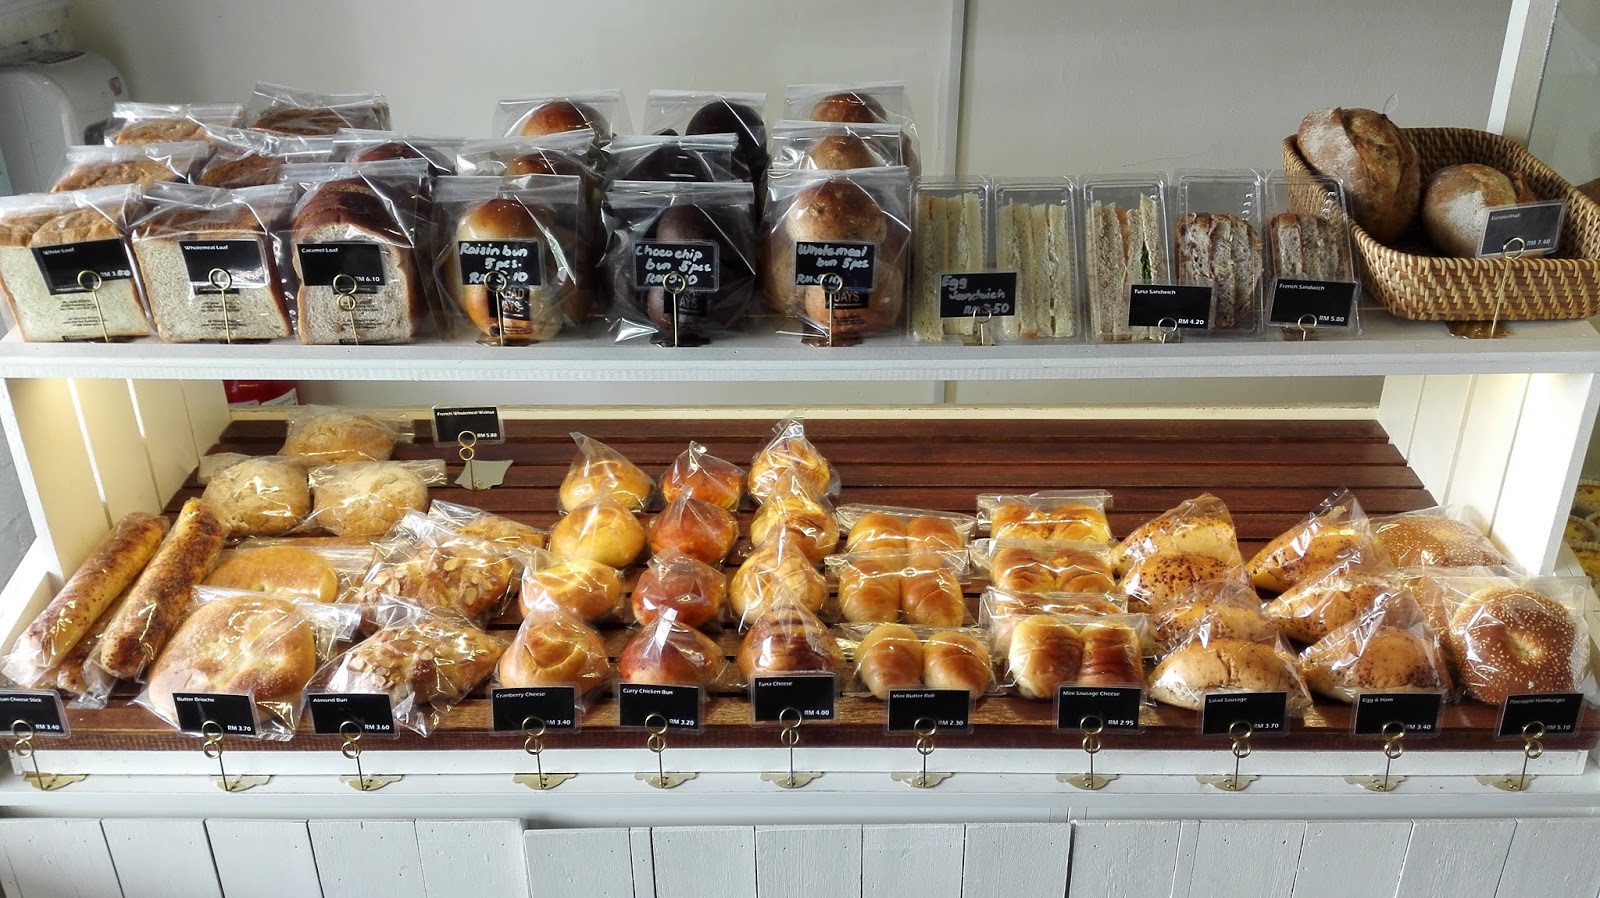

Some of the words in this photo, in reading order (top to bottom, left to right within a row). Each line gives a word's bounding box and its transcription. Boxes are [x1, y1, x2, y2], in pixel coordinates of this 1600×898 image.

[460, 242, 500, 256] Raisin
[501, 244, 528, 258] bun
[797, 244, 868, 258] Wholemeal
[644, 258, 672, 271] bun
[816, 257, 838, 268] bun
[941, 275, 968, 292] Egg
[948, 287, 1006, 302] Sandwich
